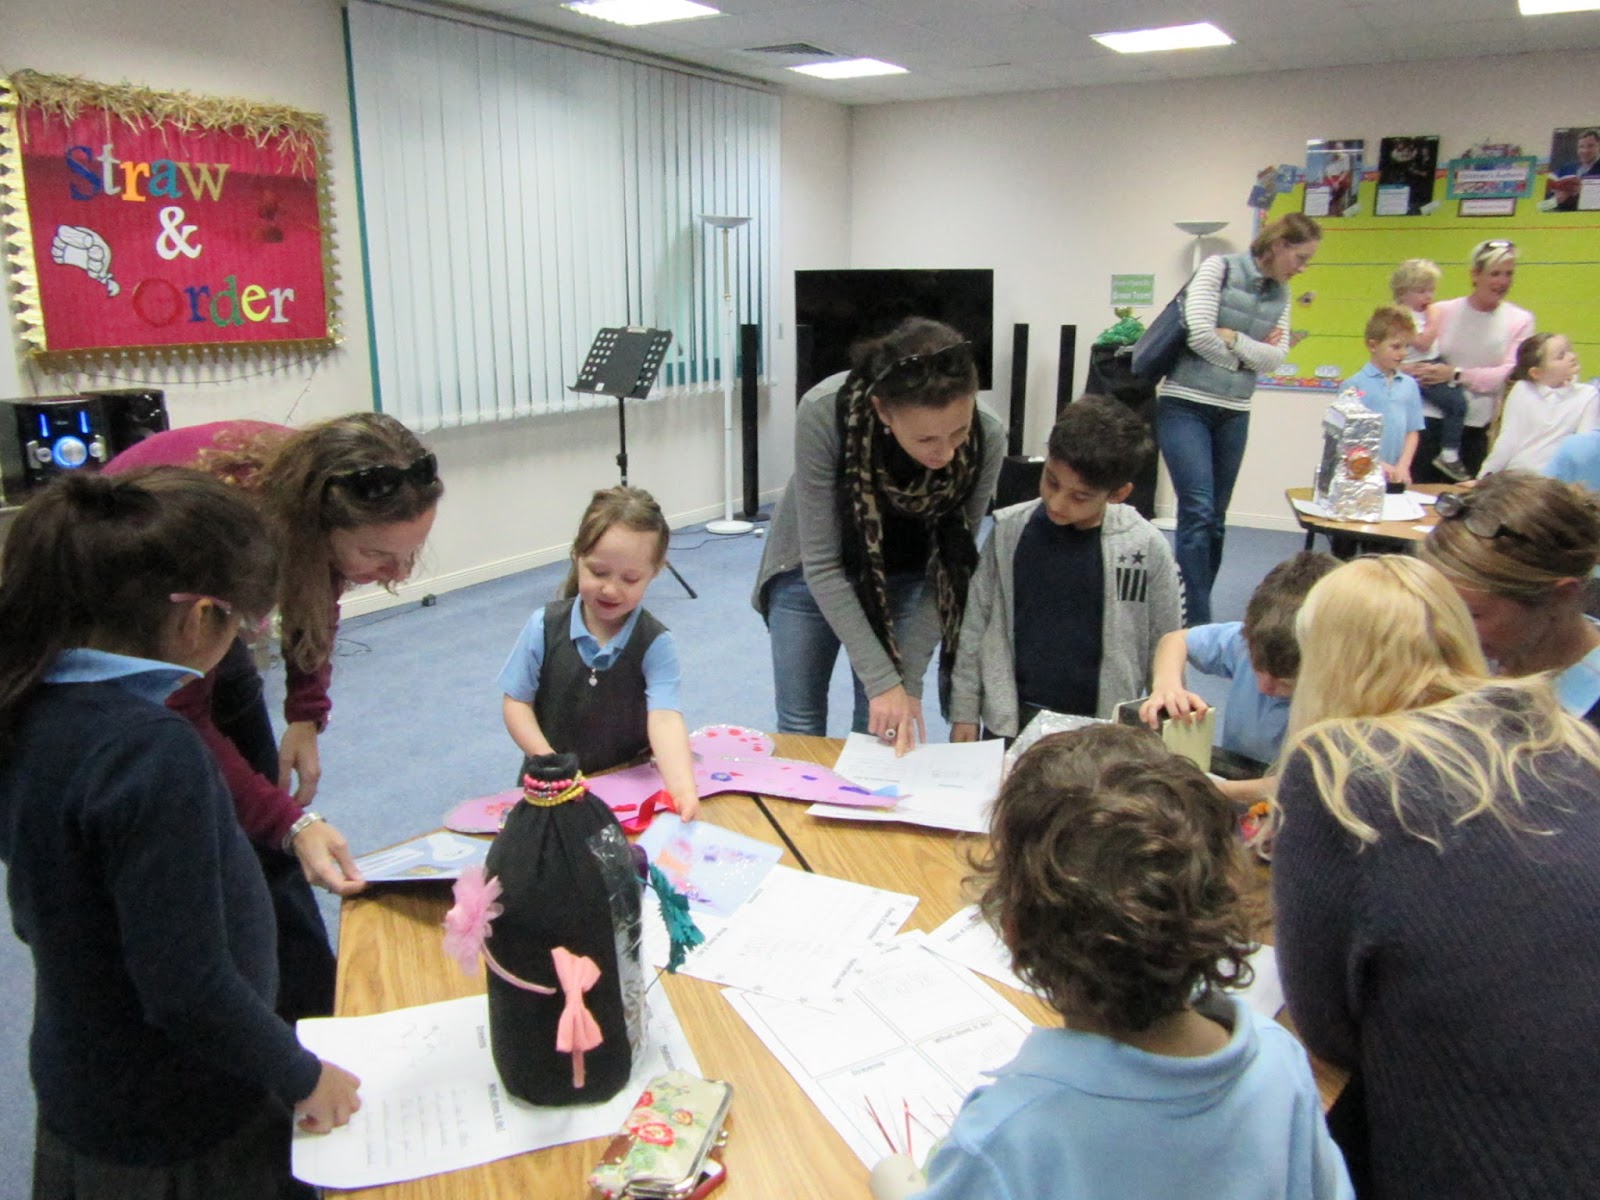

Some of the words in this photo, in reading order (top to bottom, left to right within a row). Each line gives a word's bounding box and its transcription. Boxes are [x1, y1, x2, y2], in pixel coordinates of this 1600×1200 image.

[65, 143, 231, 202] Straw
[155, 205, 202, 260] &
[132, 274, 295, 328] Order
